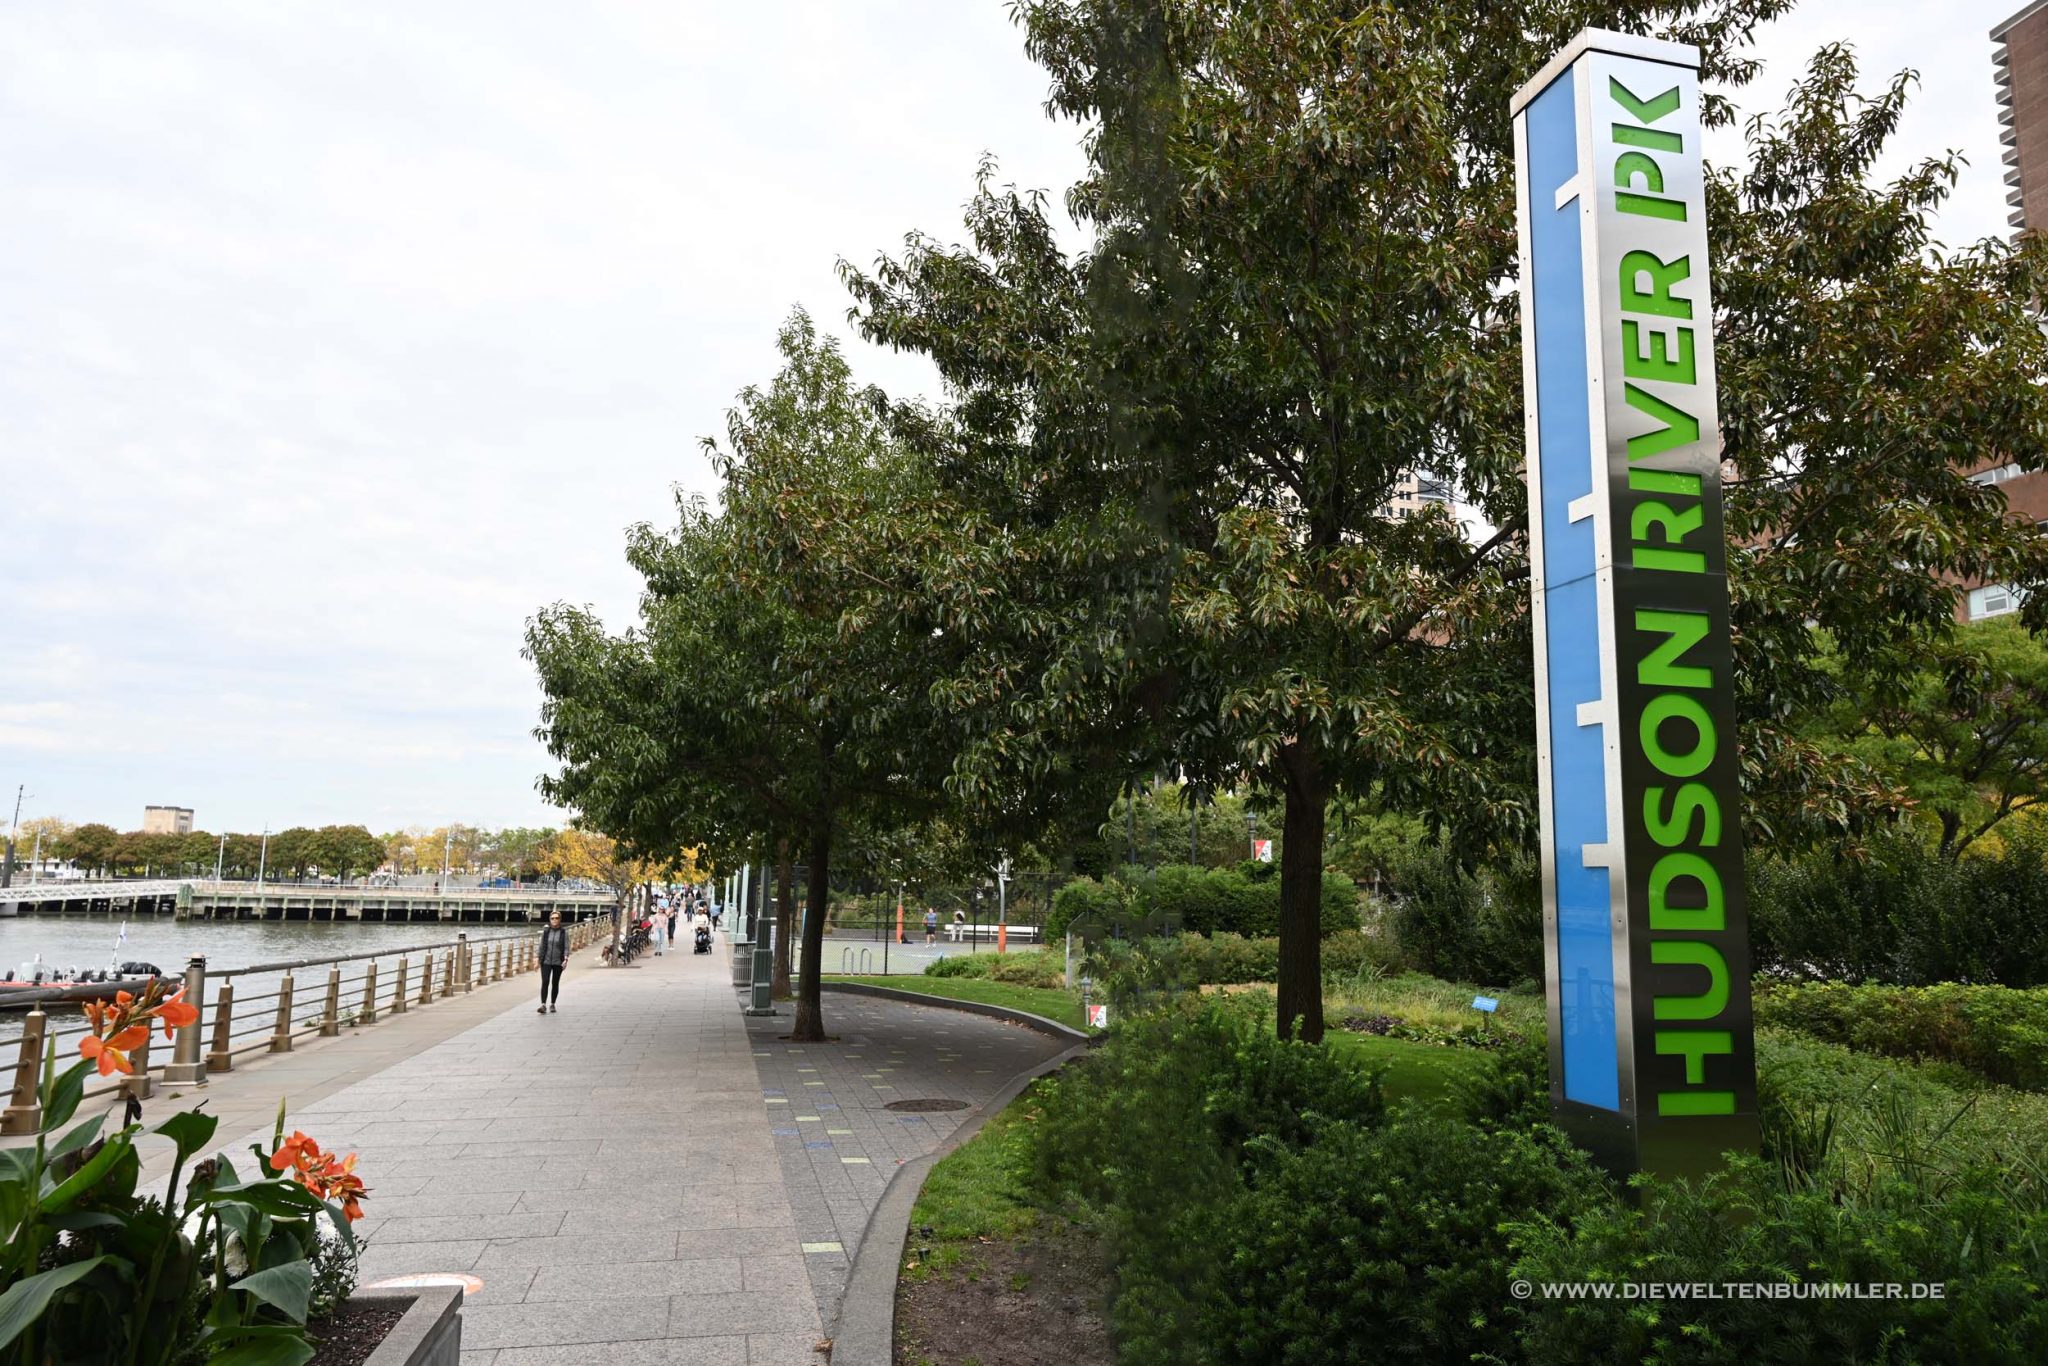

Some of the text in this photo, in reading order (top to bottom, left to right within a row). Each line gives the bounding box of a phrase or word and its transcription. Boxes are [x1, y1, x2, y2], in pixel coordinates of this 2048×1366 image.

[1609, 75, 1734, 1115] HUDSON RIVER PK
